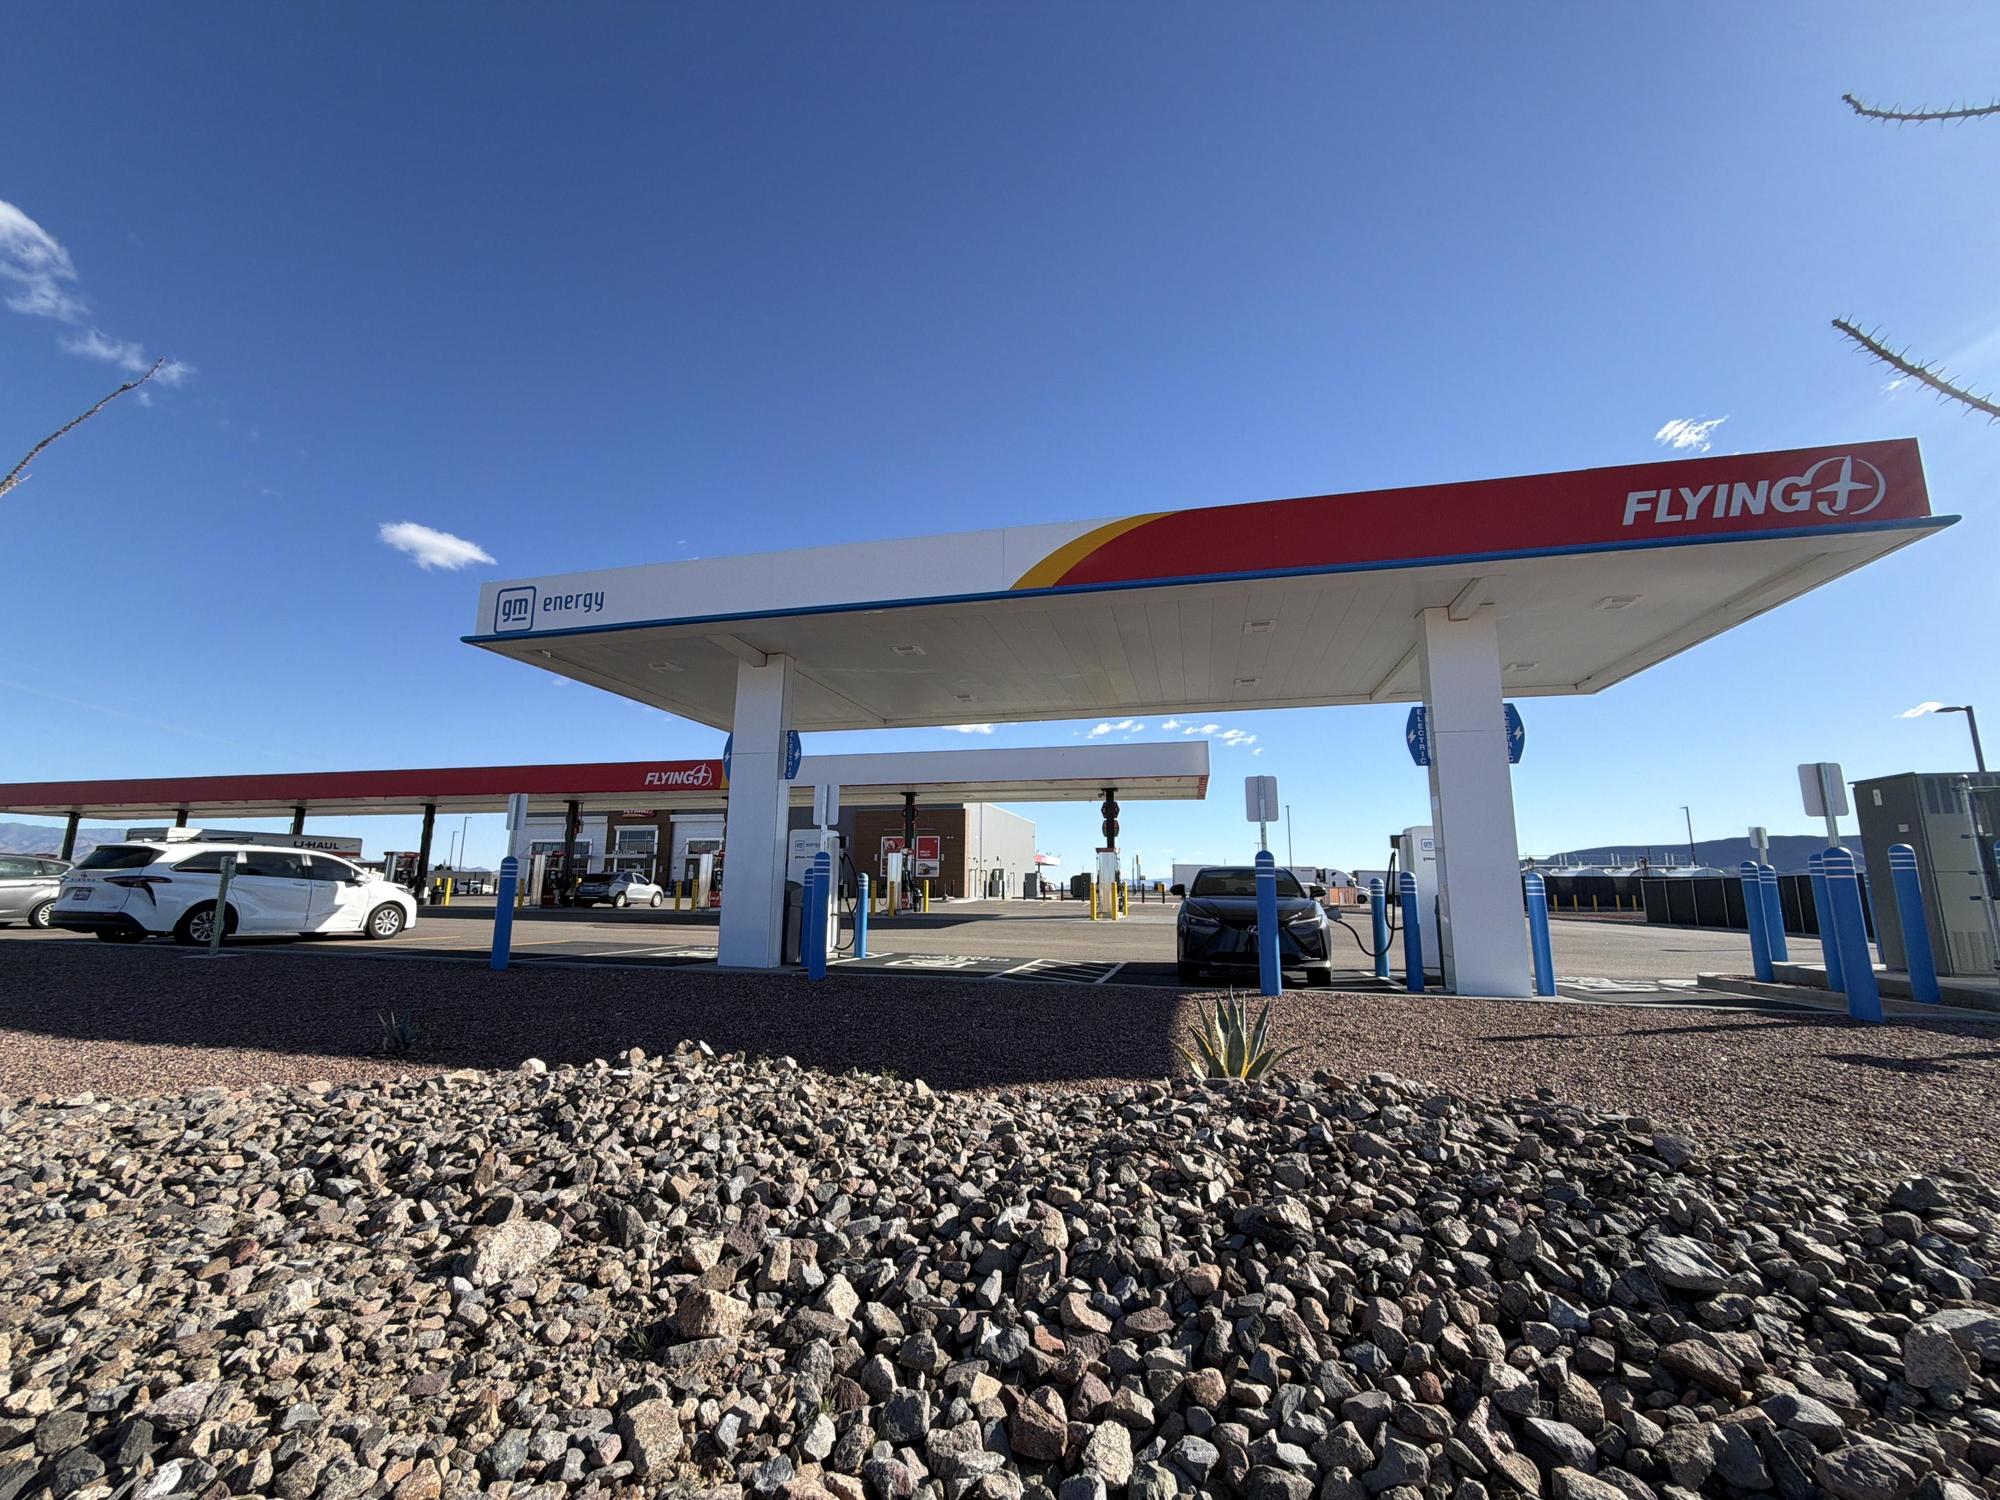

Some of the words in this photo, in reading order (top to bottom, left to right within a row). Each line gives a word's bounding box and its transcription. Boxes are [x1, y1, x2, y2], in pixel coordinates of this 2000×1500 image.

[502, 598, 529, 622] gm
[543, 591, 605, 613] energy
[787, 731, 795, 778] ELECTRIC
[1416, 708, 1427, 764] ELECTRIC
[293, 841, 340, 850] U-HAUL
